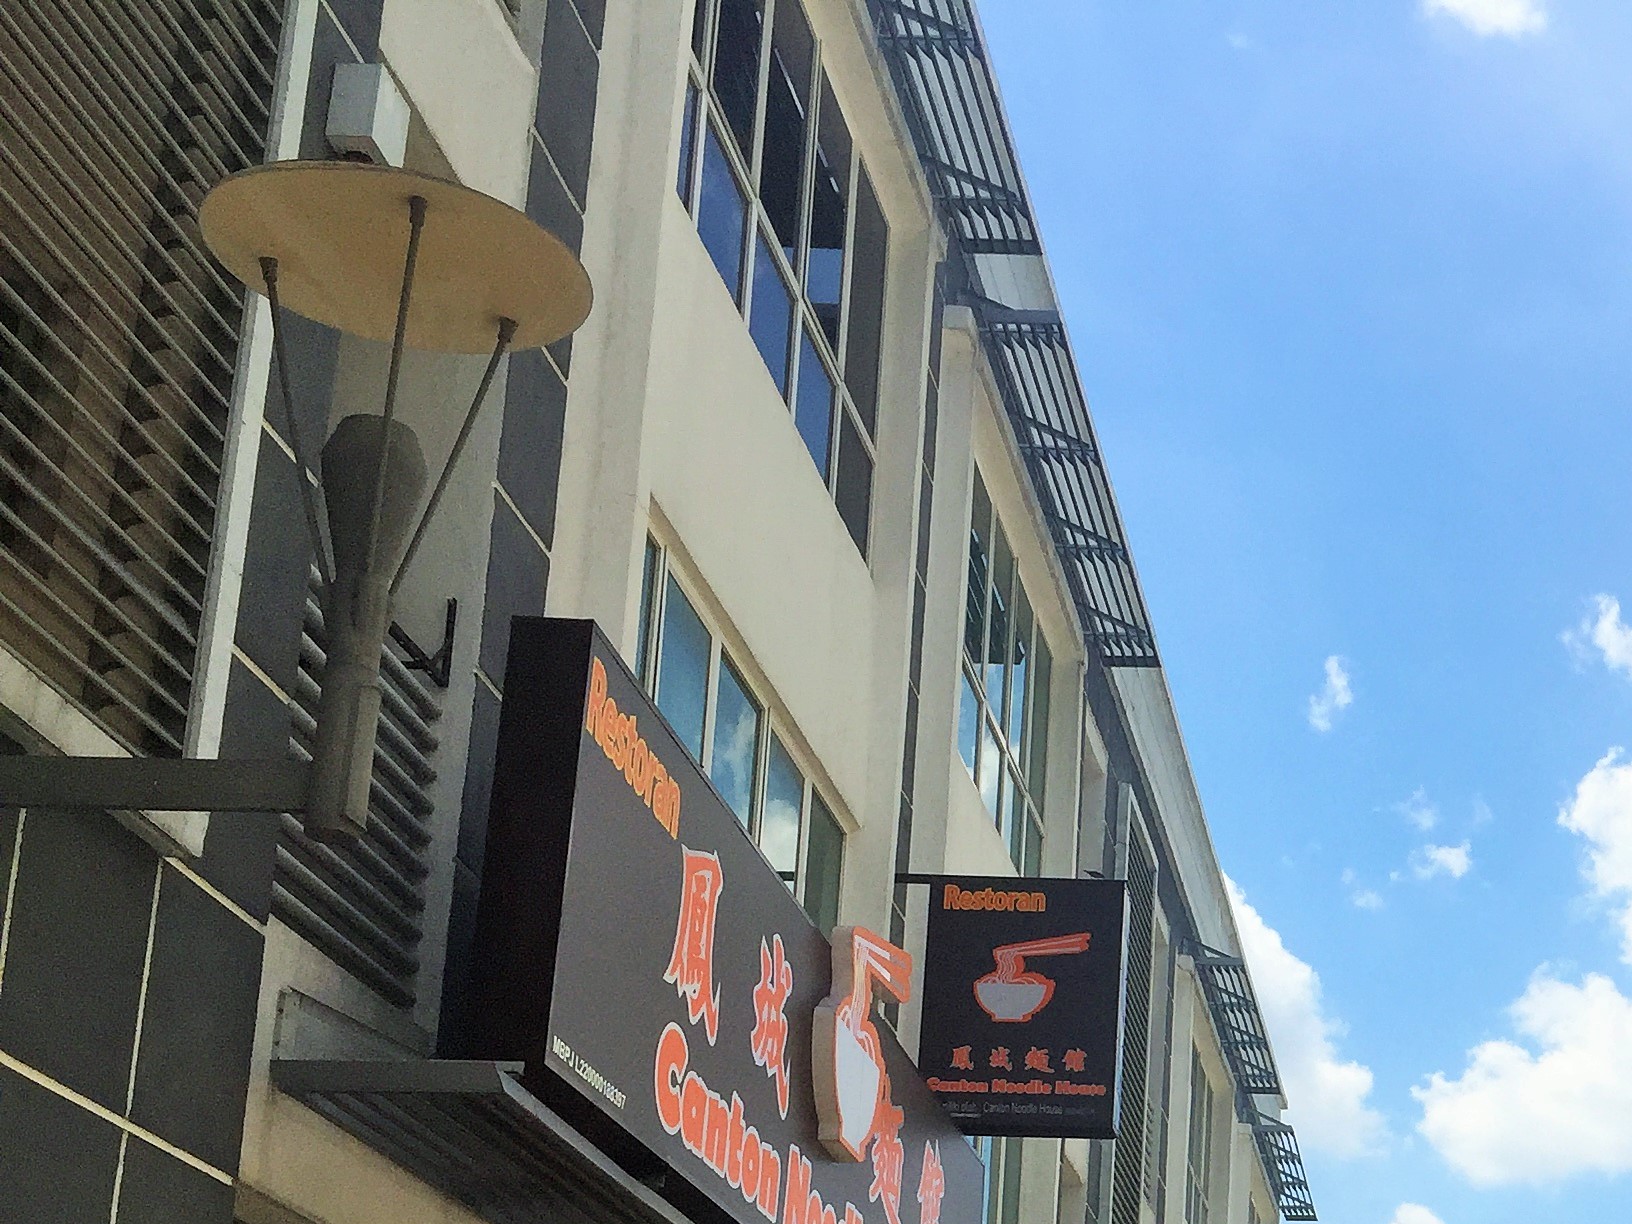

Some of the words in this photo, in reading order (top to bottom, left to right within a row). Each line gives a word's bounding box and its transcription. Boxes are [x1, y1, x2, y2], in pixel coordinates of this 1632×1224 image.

[586, 656, 681, 840] Restoran
[943, 884, 1046, 912] Restoran
[552, 1035, 575, 1068] MBPJ
[926, 1077, 989, 1094] Canton
[991, 1078, 1053, 1095] Noodle
[1055, 1081, 1107, 1097] House
[655, 1021, 781, 1224] Canton
